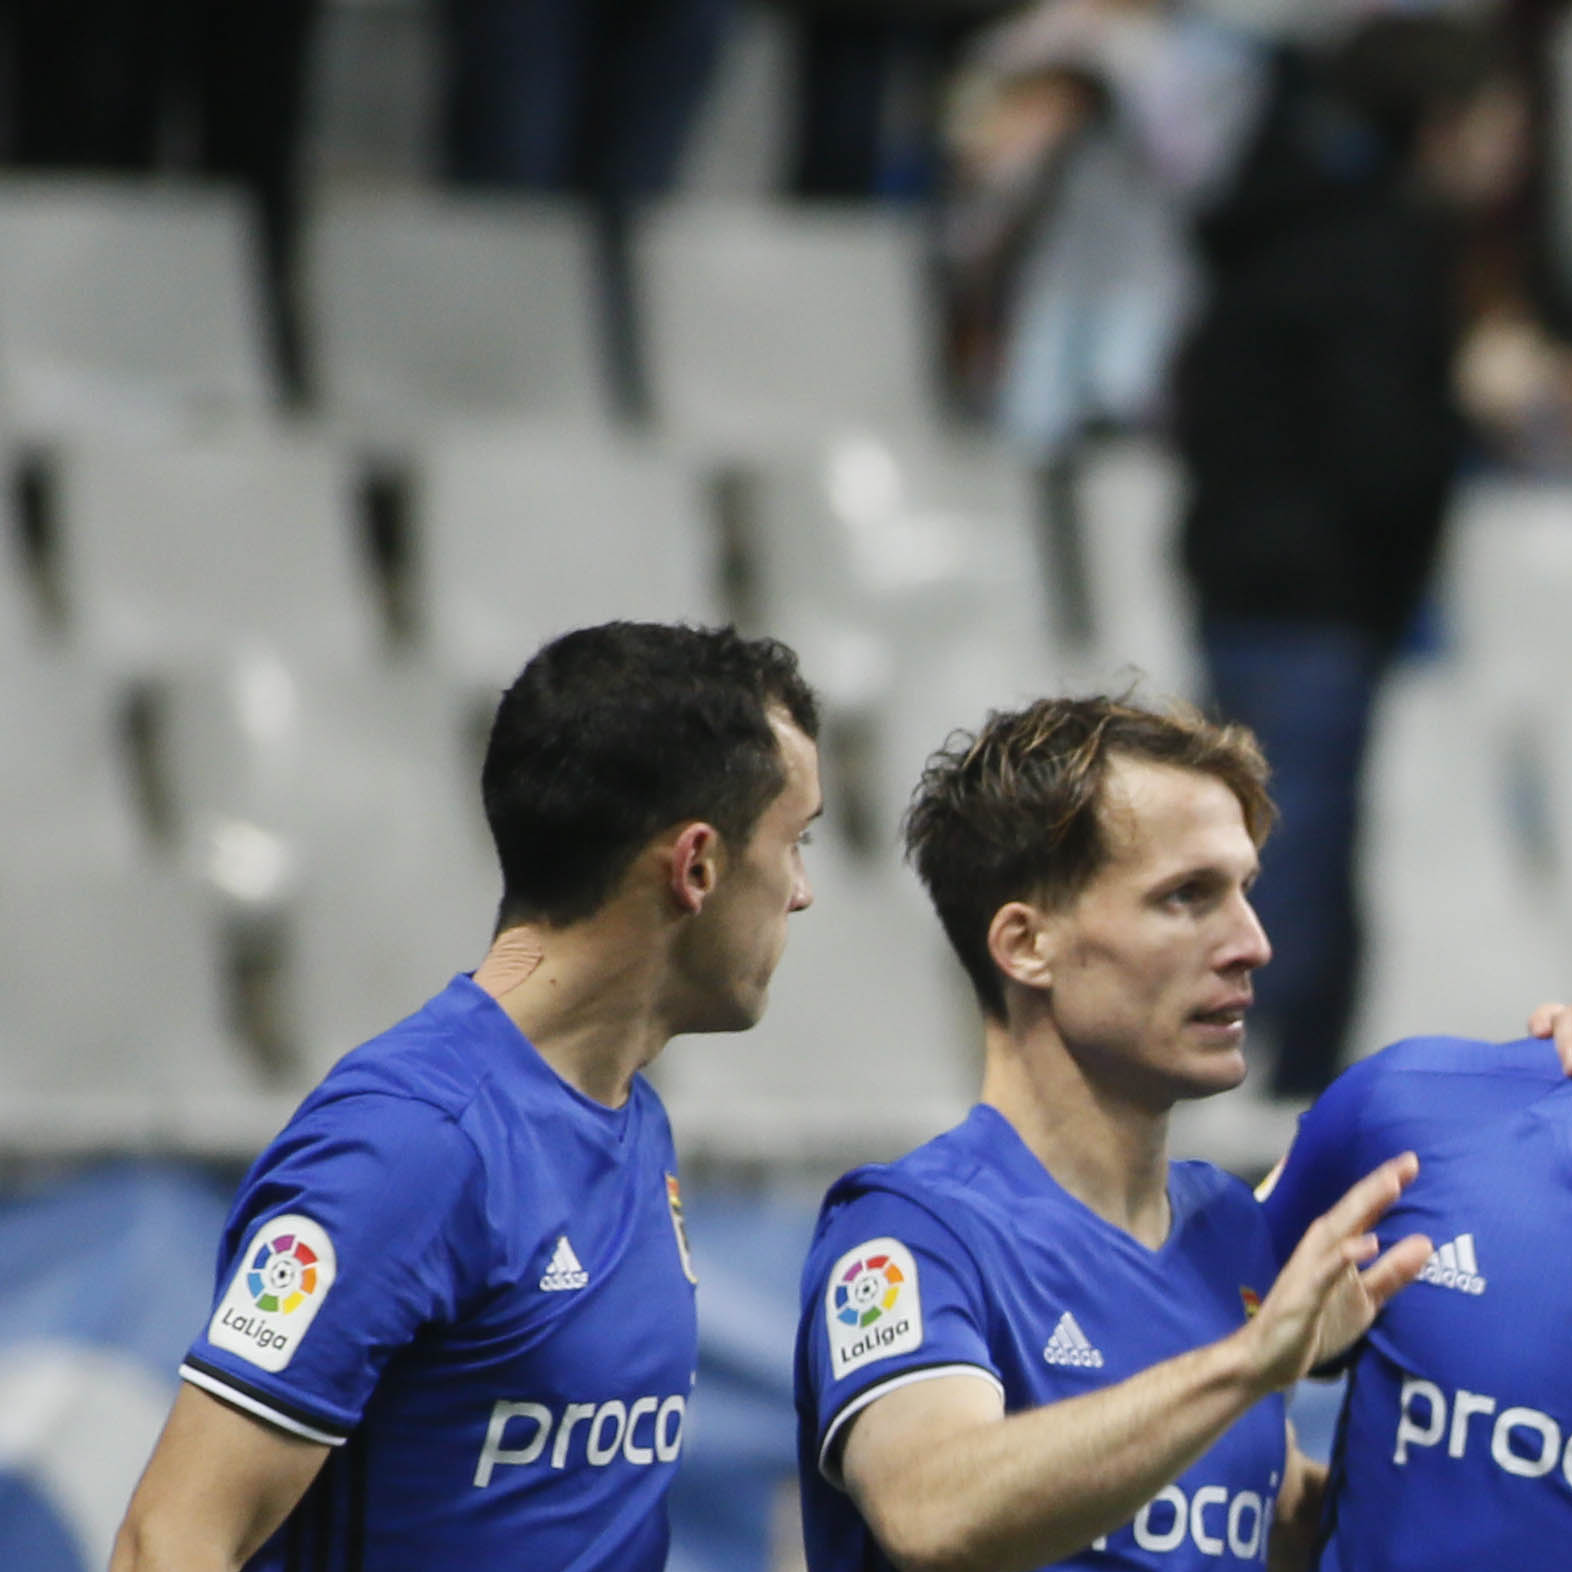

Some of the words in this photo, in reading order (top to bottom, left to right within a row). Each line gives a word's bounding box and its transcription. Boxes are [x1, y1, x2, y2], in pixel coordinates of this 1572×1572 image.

[221, 1307, 288, 1350] LaLiga
[841, 1319, 909, 1363] LaLiga
[473, 1394, 687, 1488] proco
